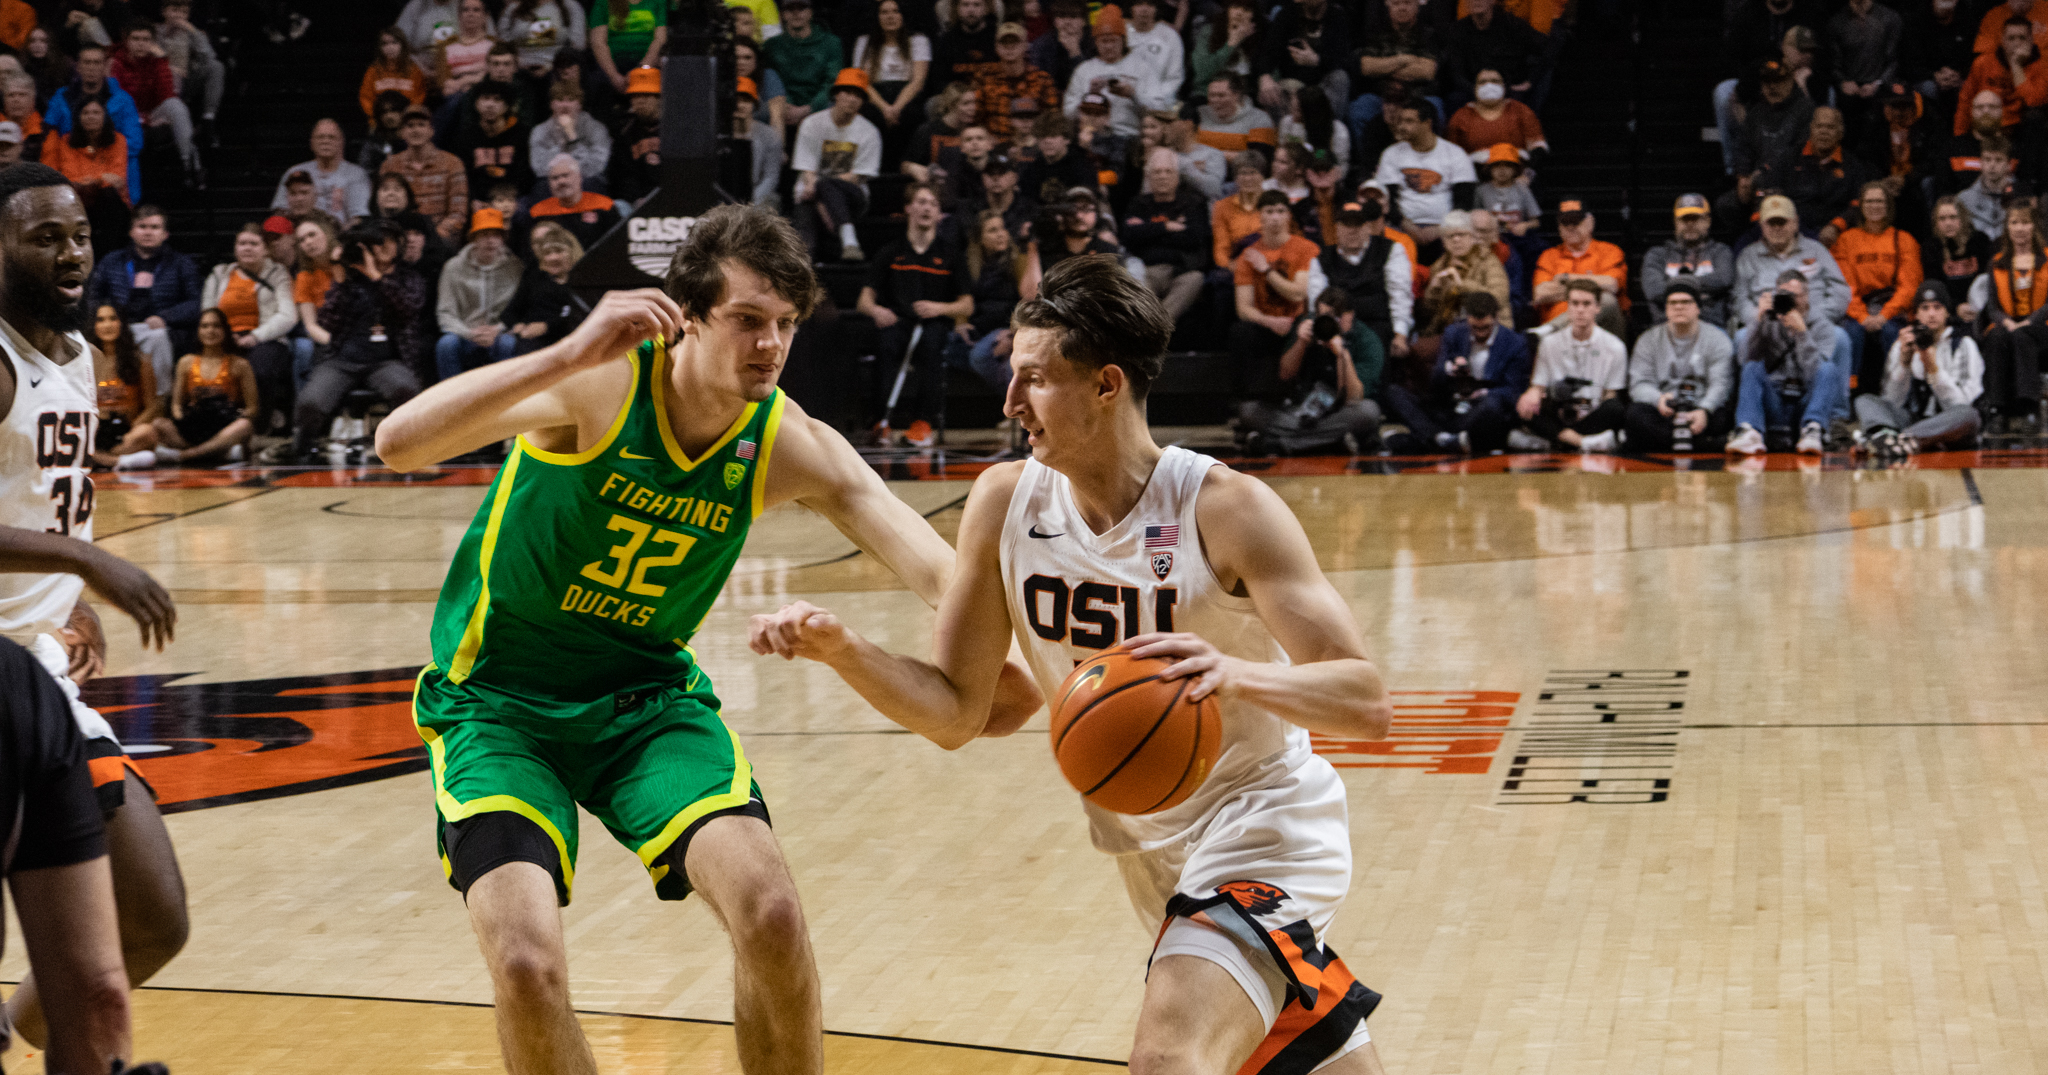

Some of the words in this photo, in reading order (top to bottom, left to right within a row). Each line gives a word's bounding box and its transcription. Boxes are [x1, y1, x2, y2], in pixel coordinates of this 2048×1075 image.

[599, 472, 734, 533] FIGHTING
[580, 513, 697, 597] 32
[1152, 553, 1172, 570] PAC
[1156, 563, 1168, 575] 12
[560, 584, 656, 627] DUCKS
[1023, 573, 1178, 649] OSU
[1528, 669, 1691, 725] RALPH
[1496, 731, 1680, 806] MILLER
